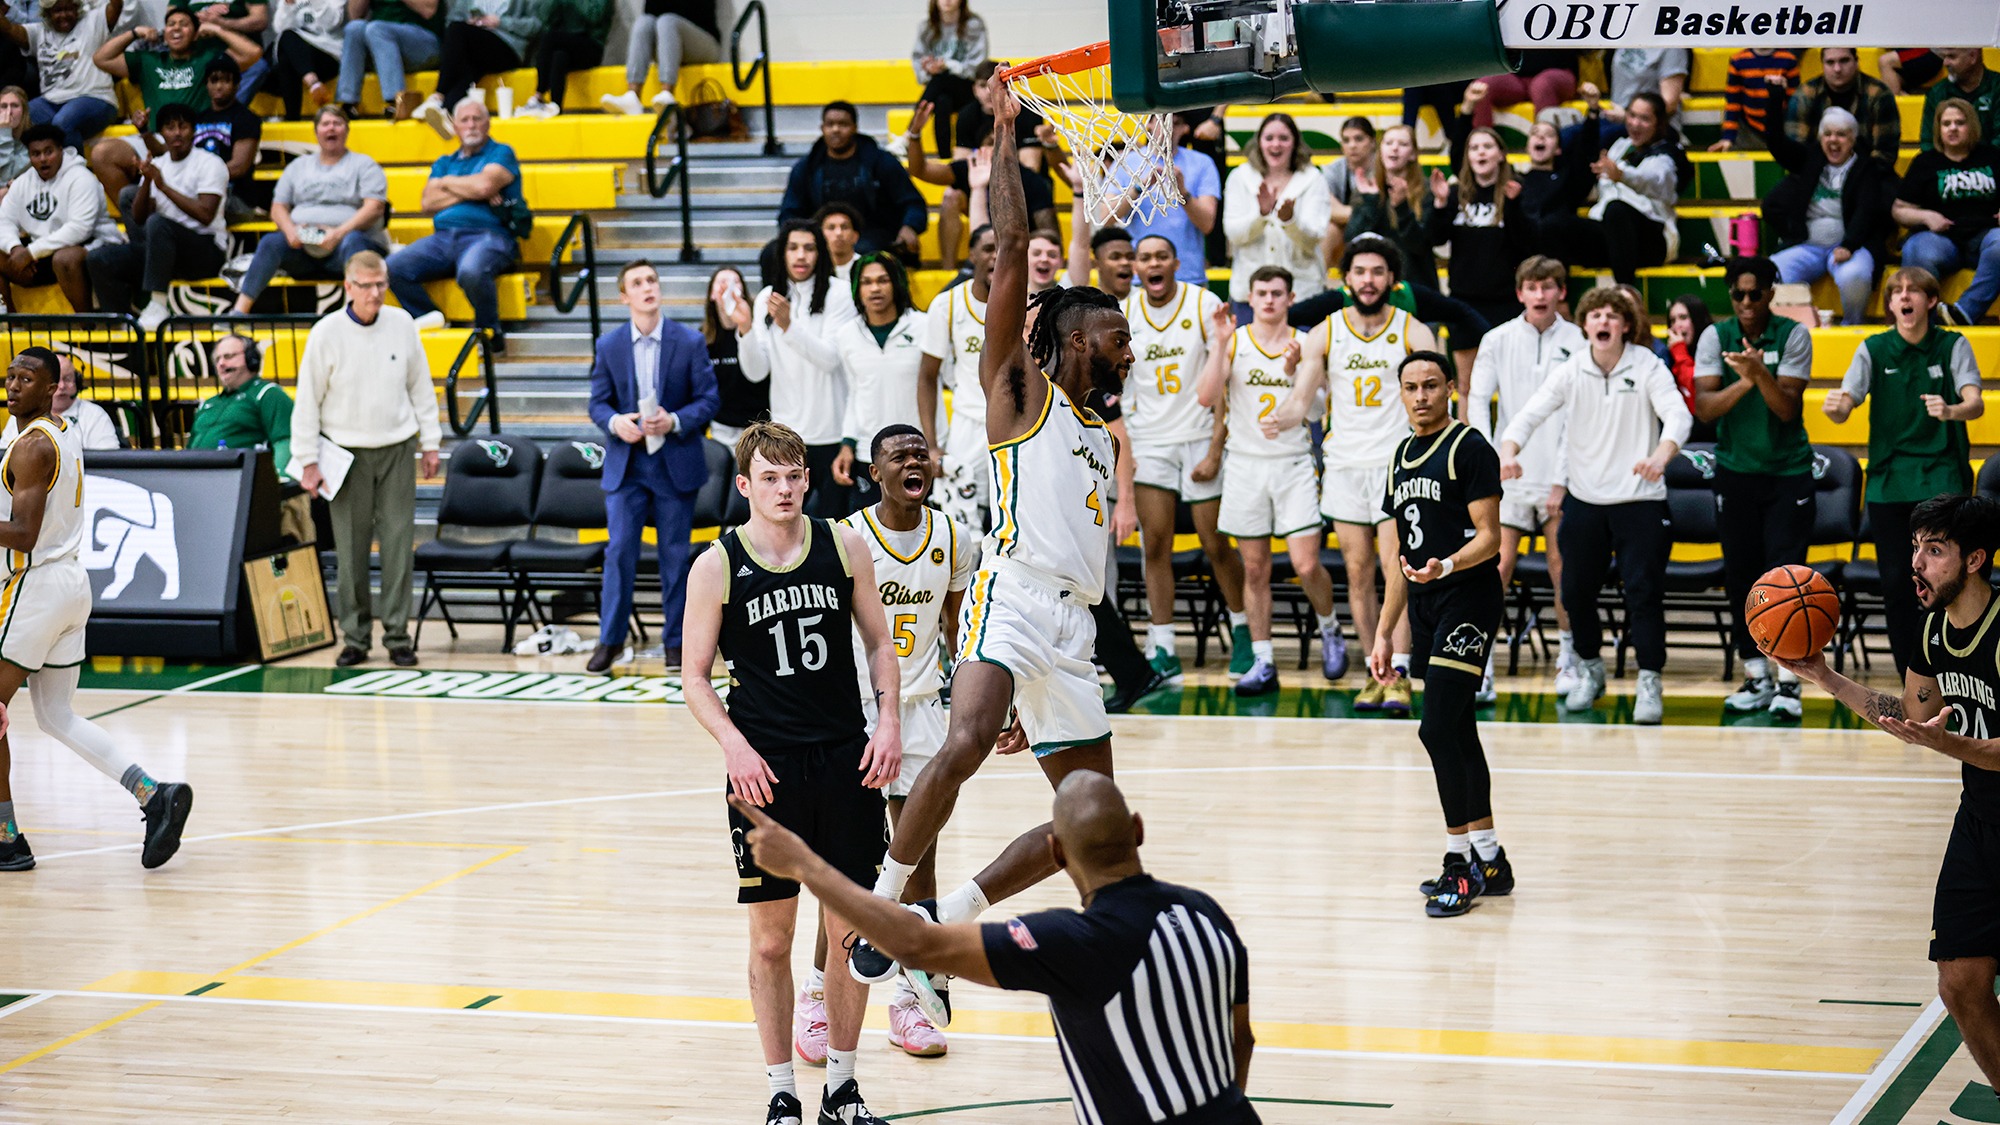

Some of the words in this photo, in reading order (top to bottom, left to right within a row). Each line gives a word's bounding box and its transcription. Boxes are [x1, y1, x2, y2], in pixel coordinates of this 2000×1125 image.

[1523, 3, 1639, 41] OBU
[1654, 4, 1863, 36] Basketball
[1155, 363, 1181, 395] 15
[1353, 376, 1382, 406] 12
[1258, 393, 1276, 420] 2
[1086, 480, 1104, 527] 4
[1404, 503, 1424, 550] 3
[746, 583, 839, 626] HARDING
[879, 580, 934, 606] Bison
[768, 613, 828, 677] 15
[893, 613, 917, 657] 5
